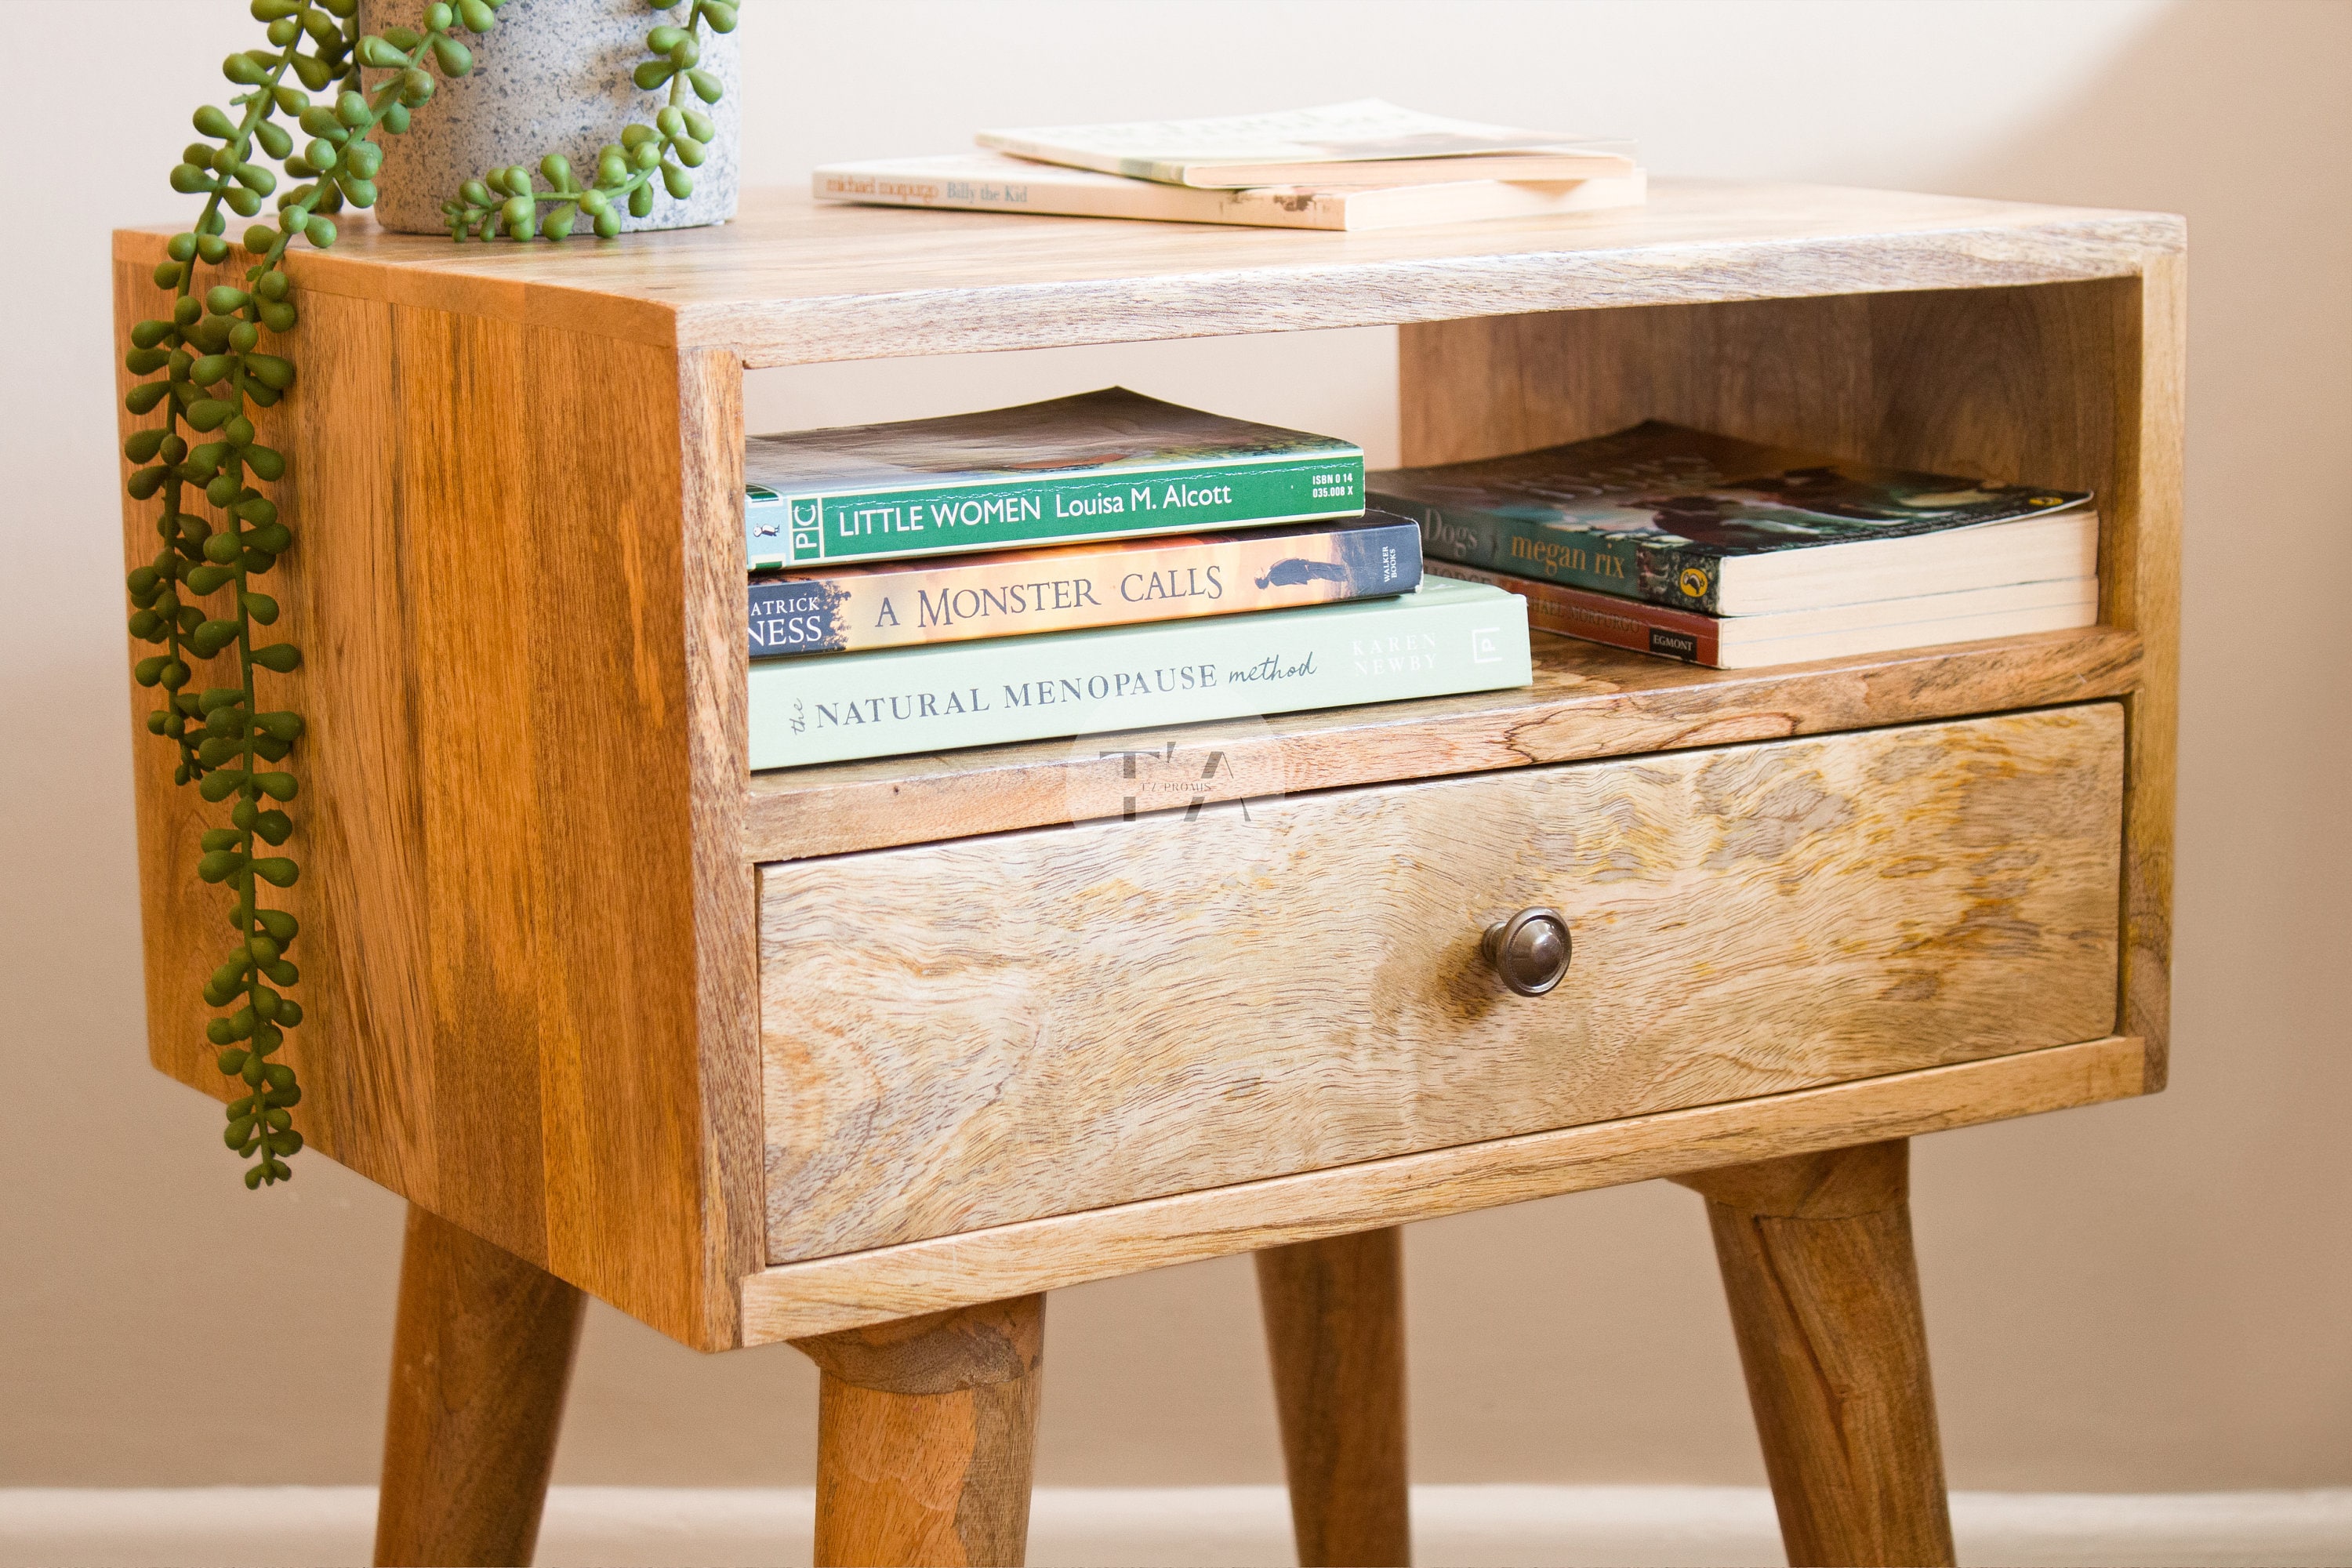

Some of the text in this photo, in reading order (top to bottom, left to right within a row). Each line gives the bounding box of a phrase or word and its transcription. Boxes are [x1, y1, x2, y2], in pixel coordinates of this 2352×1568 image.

[946, 181, 1028, 204] Billy the Kid
[1312, 474, 1334, 485] ISBN
[1343, 472, 1353, 483] 14
[1312, 485, 1353, 498] 035.008 X
[839, 495, 1041, 537] LITTLE WOMEN
[1055, 485, 1232, 518] Louisa M. Alcott
[1423, 508, 1478, 557] Dogs
[1382, 546, 1391, 583] WALKER
[1389, 548, 1398, 579] BOOKS
[1511, 535, 1587, 577] megan
[1595, 543, 1625, 579] rix
[750, 597, 820, 617] ATRICK
[875, 565, 1223, 629] A MONSTER CALLS
[1352, 632, 1437, 657] KAREN
[1653, 633, 1693, 652] EGMONT
[1356, 652, 1438, 678] NEWBY
[789, 651, 1319, 736] the NATURAL MENOPAUSE method
